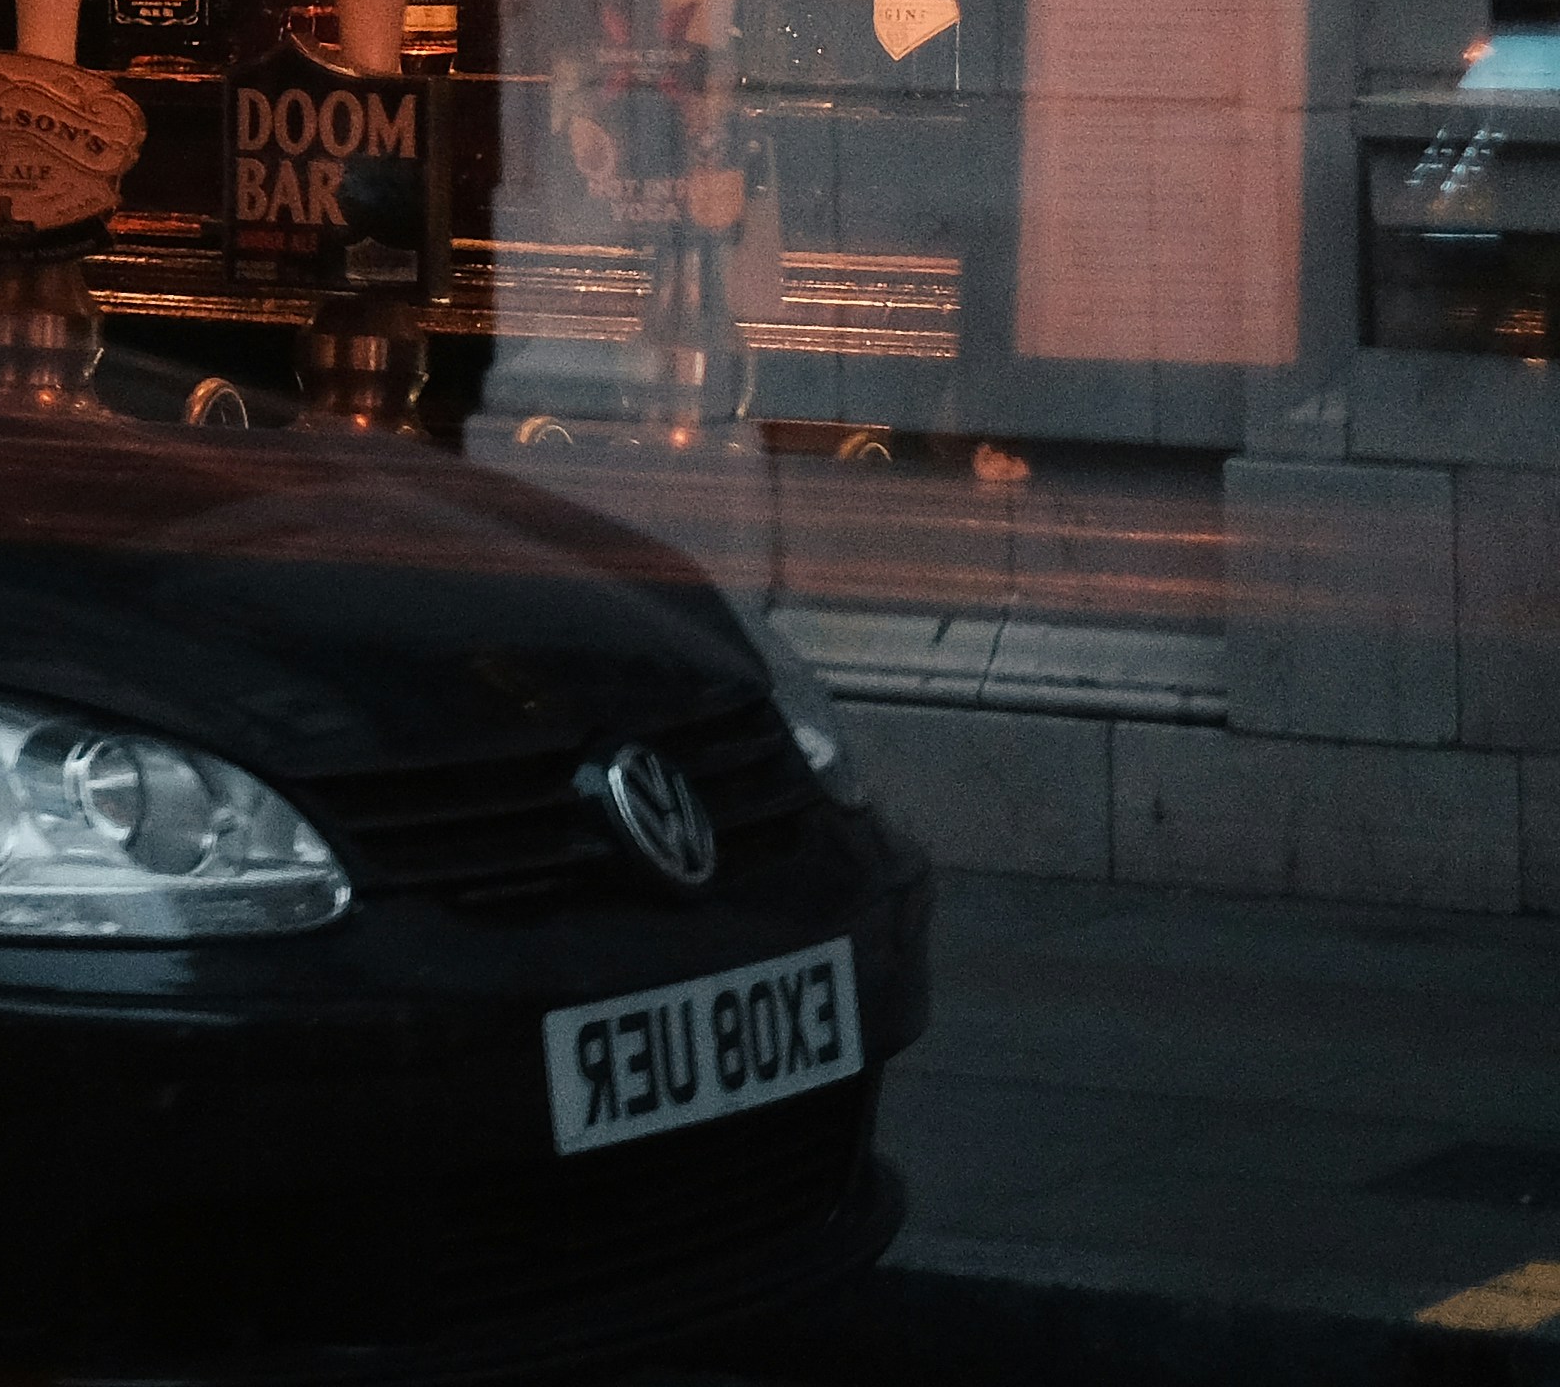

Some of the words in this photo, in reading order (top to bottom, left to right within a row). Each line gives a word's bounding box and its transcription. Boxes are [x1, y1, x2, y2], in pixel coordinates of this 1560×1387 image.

[236, 86, 418, 159] DOOM
[12, 164, 53, 181] ALE
[235, 154, 350, 228] BAR
